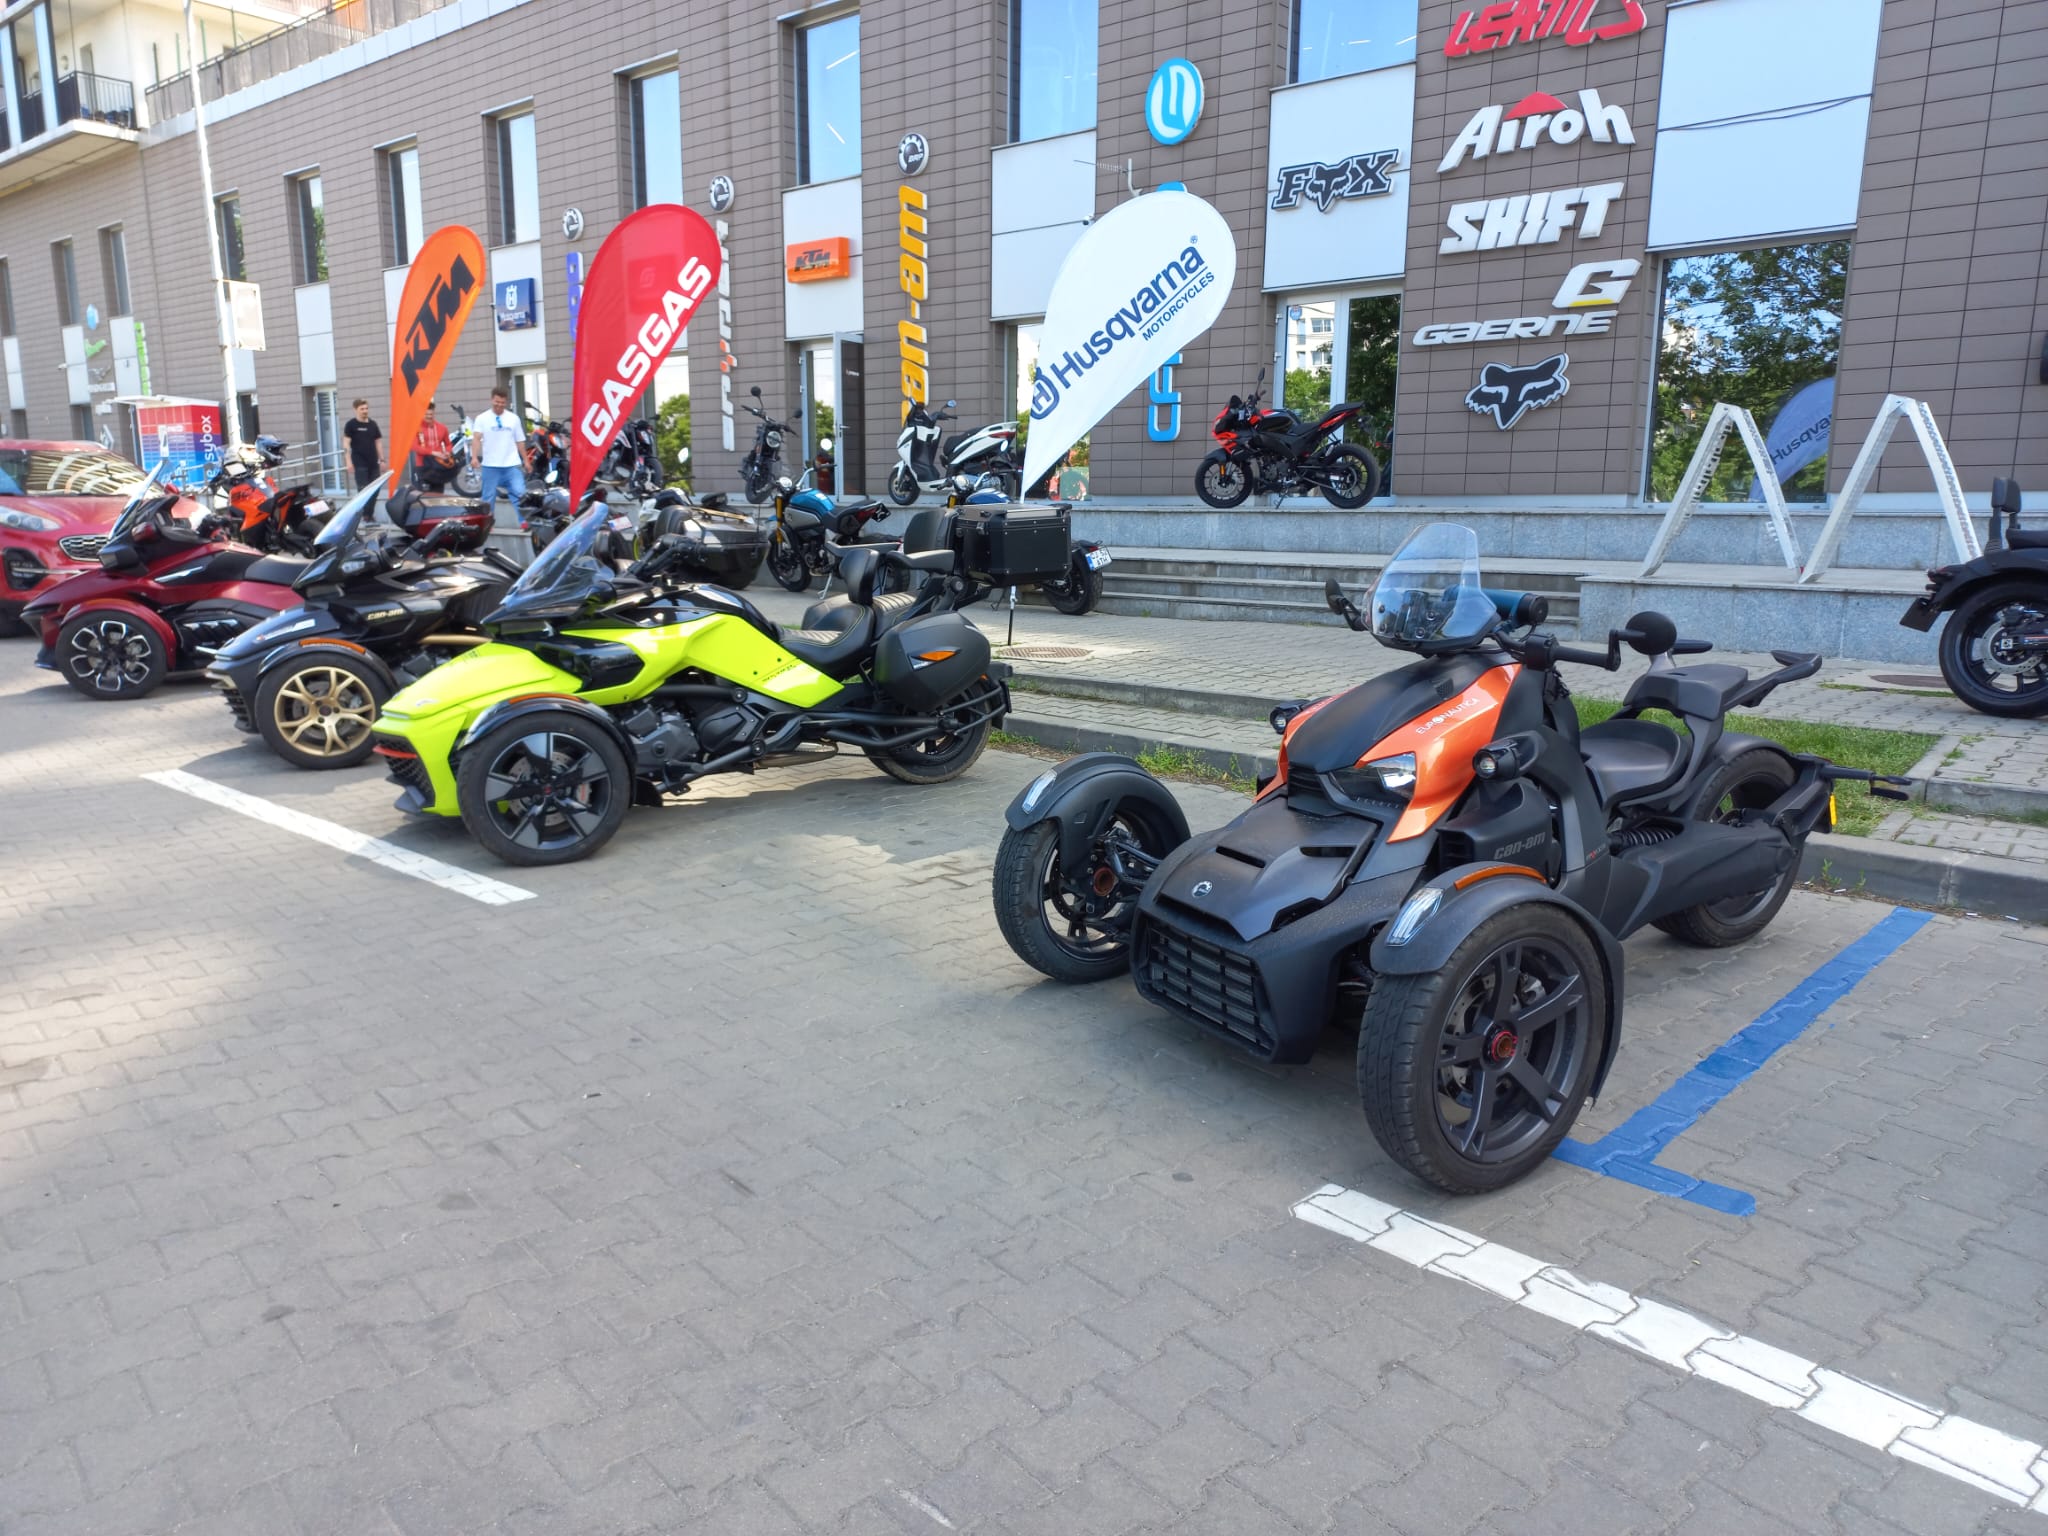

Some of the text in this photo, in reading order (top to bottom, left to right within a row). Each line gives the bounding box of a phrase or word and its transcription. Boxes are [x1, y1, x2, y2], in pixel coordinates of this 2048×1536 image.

[1436, 88, 1636, 174] Airoh
[1438, 181, 1625, 255] SHIFT
[794, 249, 830, 272] KTM
[1552, 258, 1642, 309] G
[401, 253, 475, 397] KTM
[1050, 246, 1205, 390] Husqvarna
[1142, 271, 1215, 341] MOTORCYCLES
[581, 256, 712, 447] GASGAS
[200, 415, 217, 478] esybox
[1493, 831, 1546, 860] can-am
